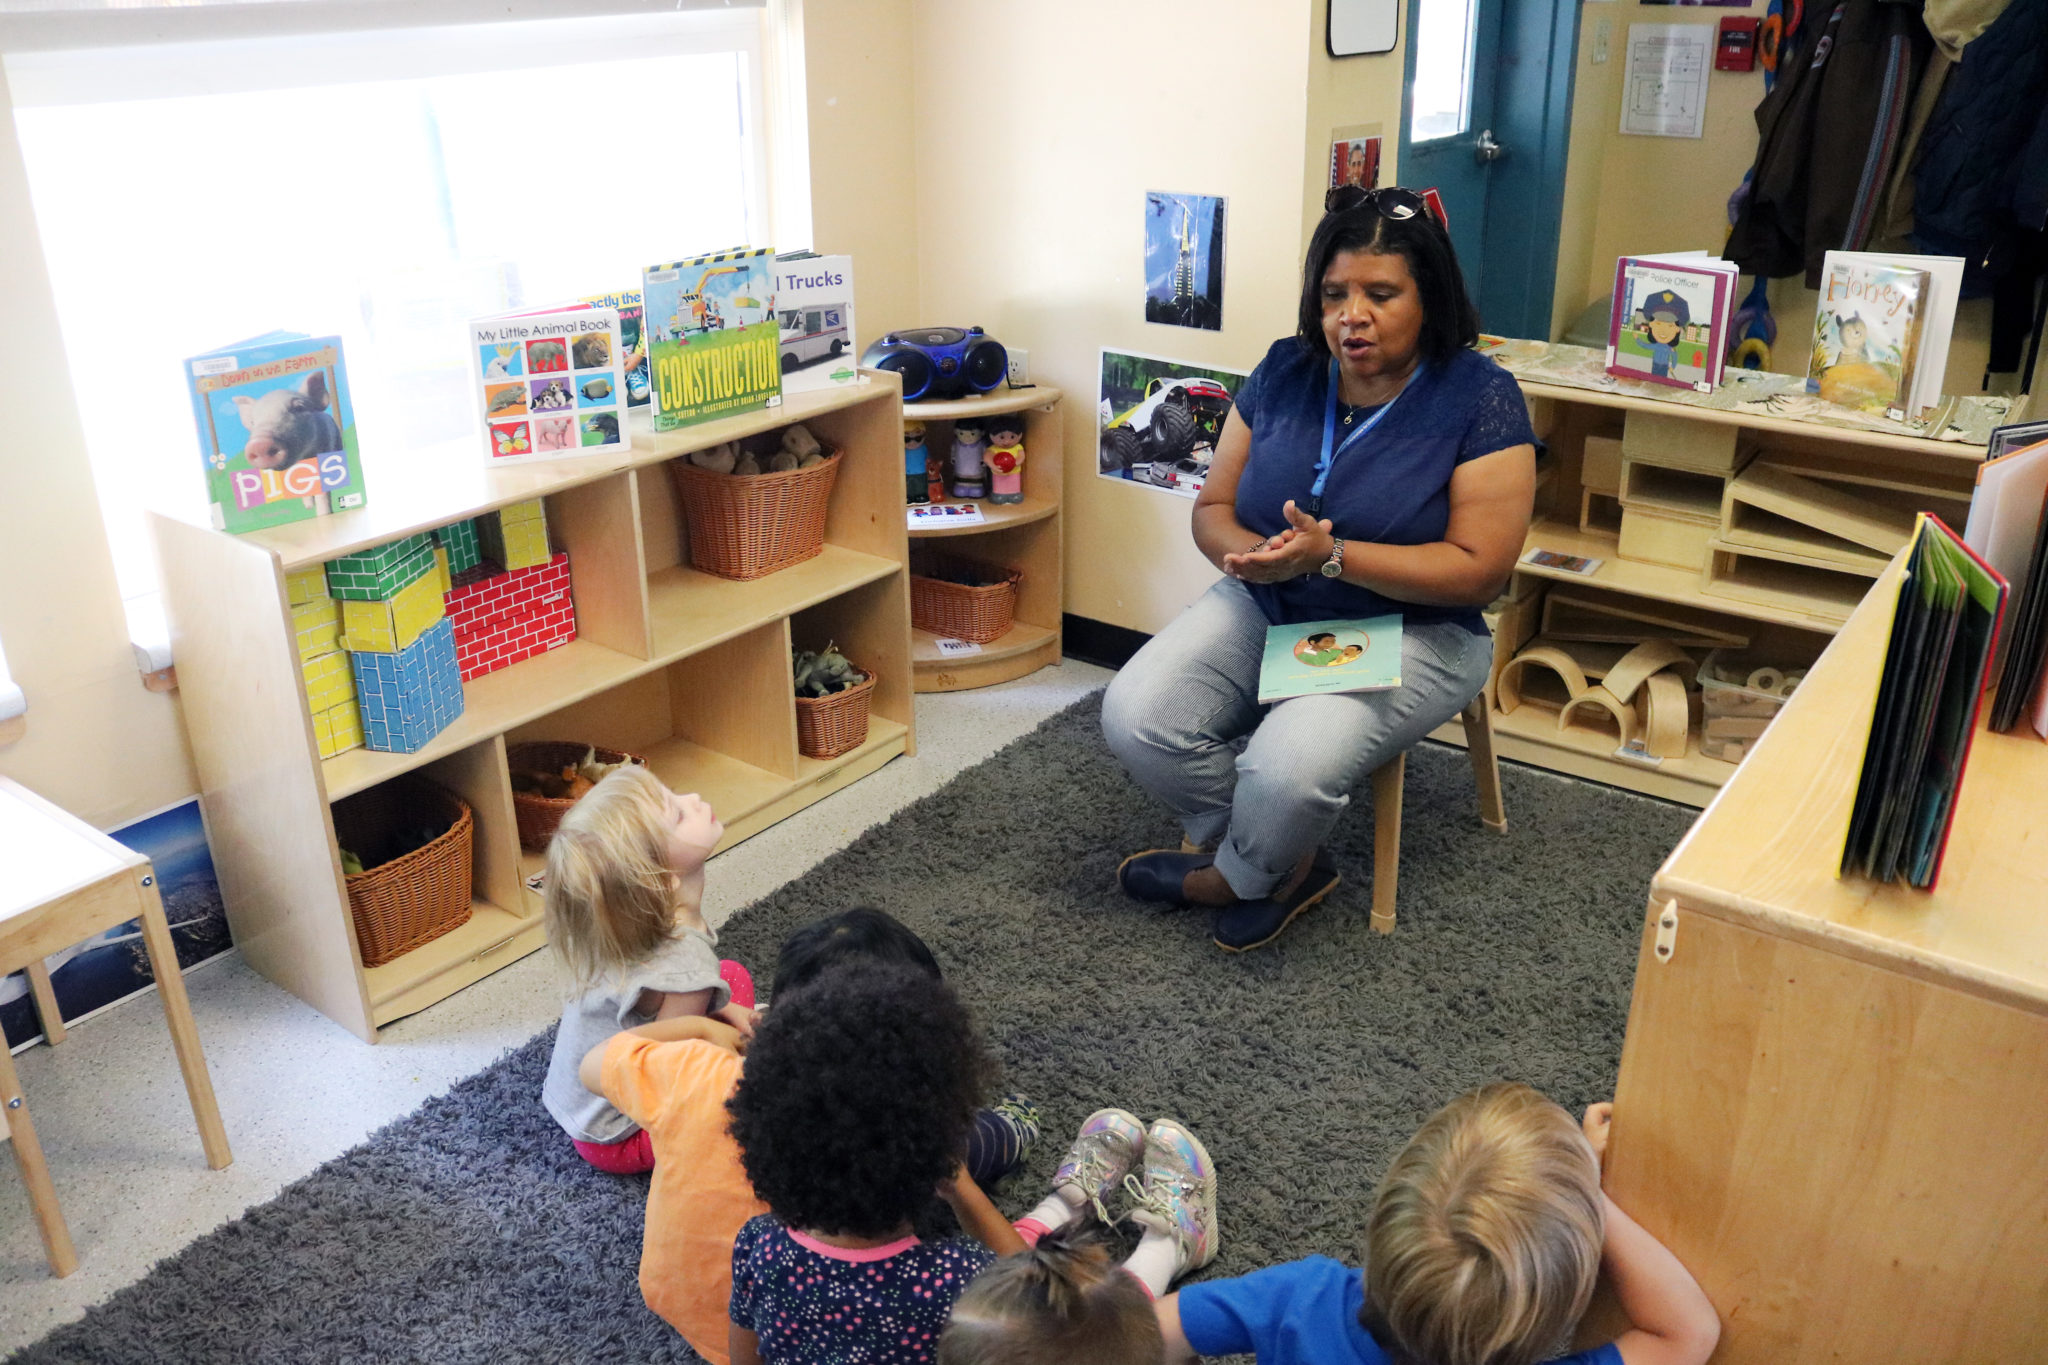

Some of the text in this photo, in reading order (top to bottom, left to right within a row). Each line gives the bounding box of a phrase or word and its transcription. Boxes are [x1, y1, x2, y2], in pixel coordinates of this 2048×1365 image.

[785, 270, 843, 290] Trucks
[1674, 277, 1699, 289] Officer
[590, 292, 641, 309] actly the
[1827, 272, 1906, 317] Honey
[619, 309, 642, 320] BAN
[478, 318, 611, 342] My Little Animal Book
[221, 369, 250, 387] Down
[284, 356, 318, 373] Farm
[659, 337, 778, 411] CONSTRUCTION
[236, 454, 348, 508] PIGS
